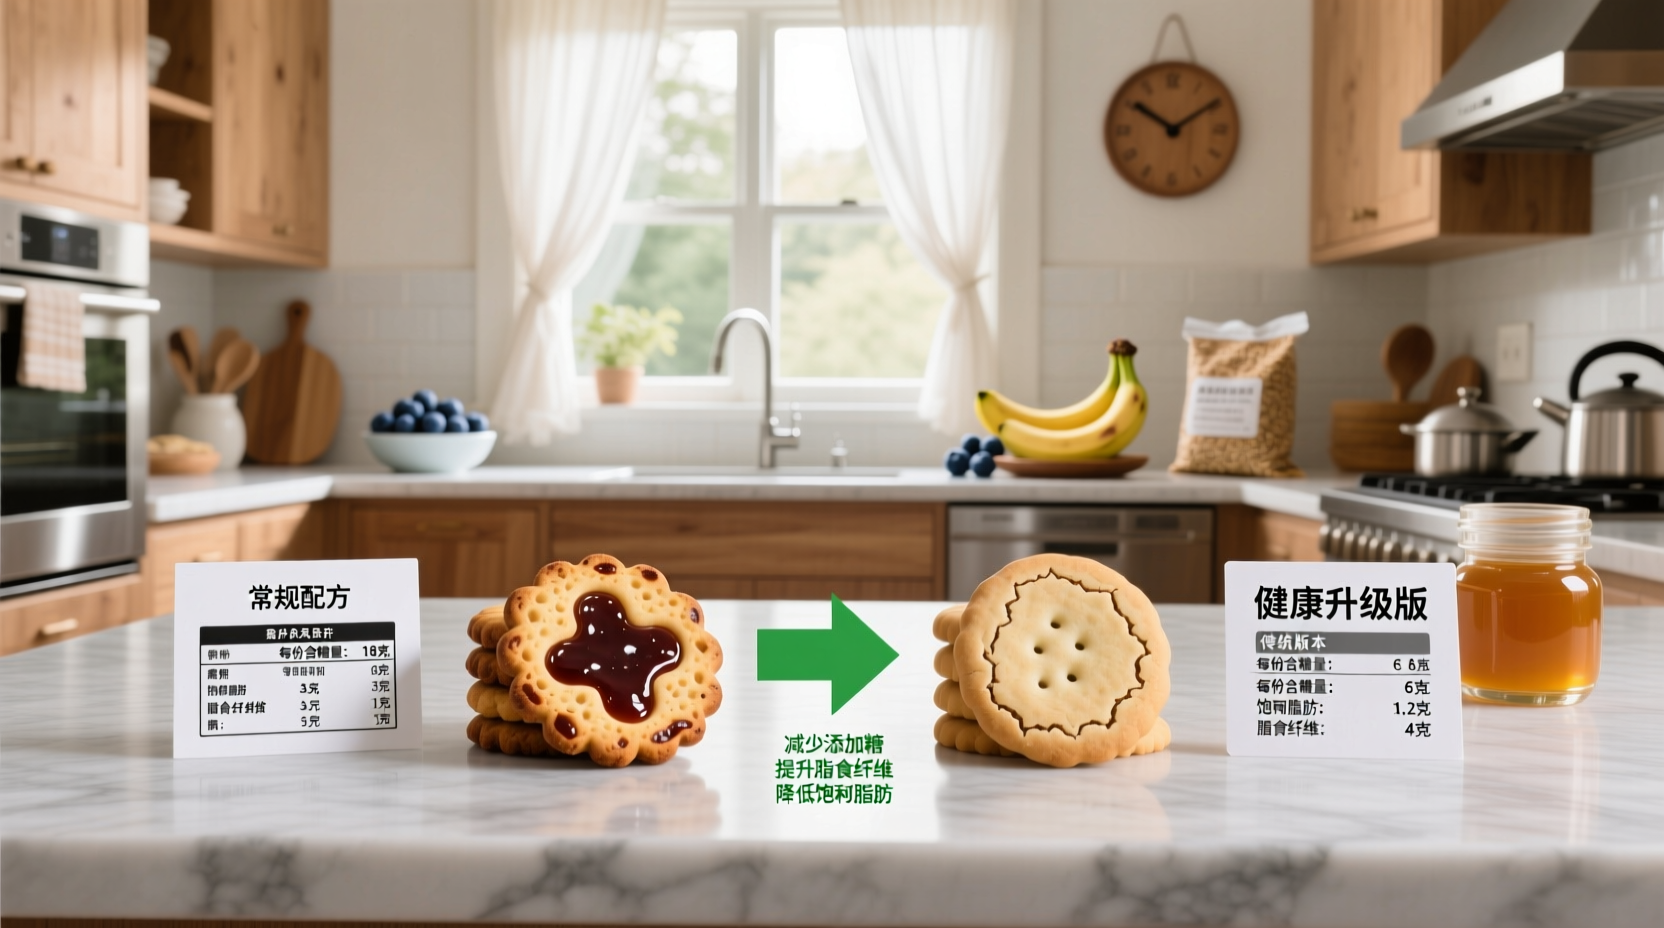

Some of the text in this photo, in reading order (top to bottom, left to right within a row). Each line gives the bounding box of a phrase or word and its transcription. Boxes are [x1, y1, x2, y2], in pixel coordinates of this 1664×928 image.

[248, 583, 351, 611] 常规配方
[1254, 585, 1428, 621] 健康升级版
[1404, 679, 1431, 695] 6克
[1393, 700, 1432, 716] 1.2克
[1404, 721, 1432, 738] 4克
